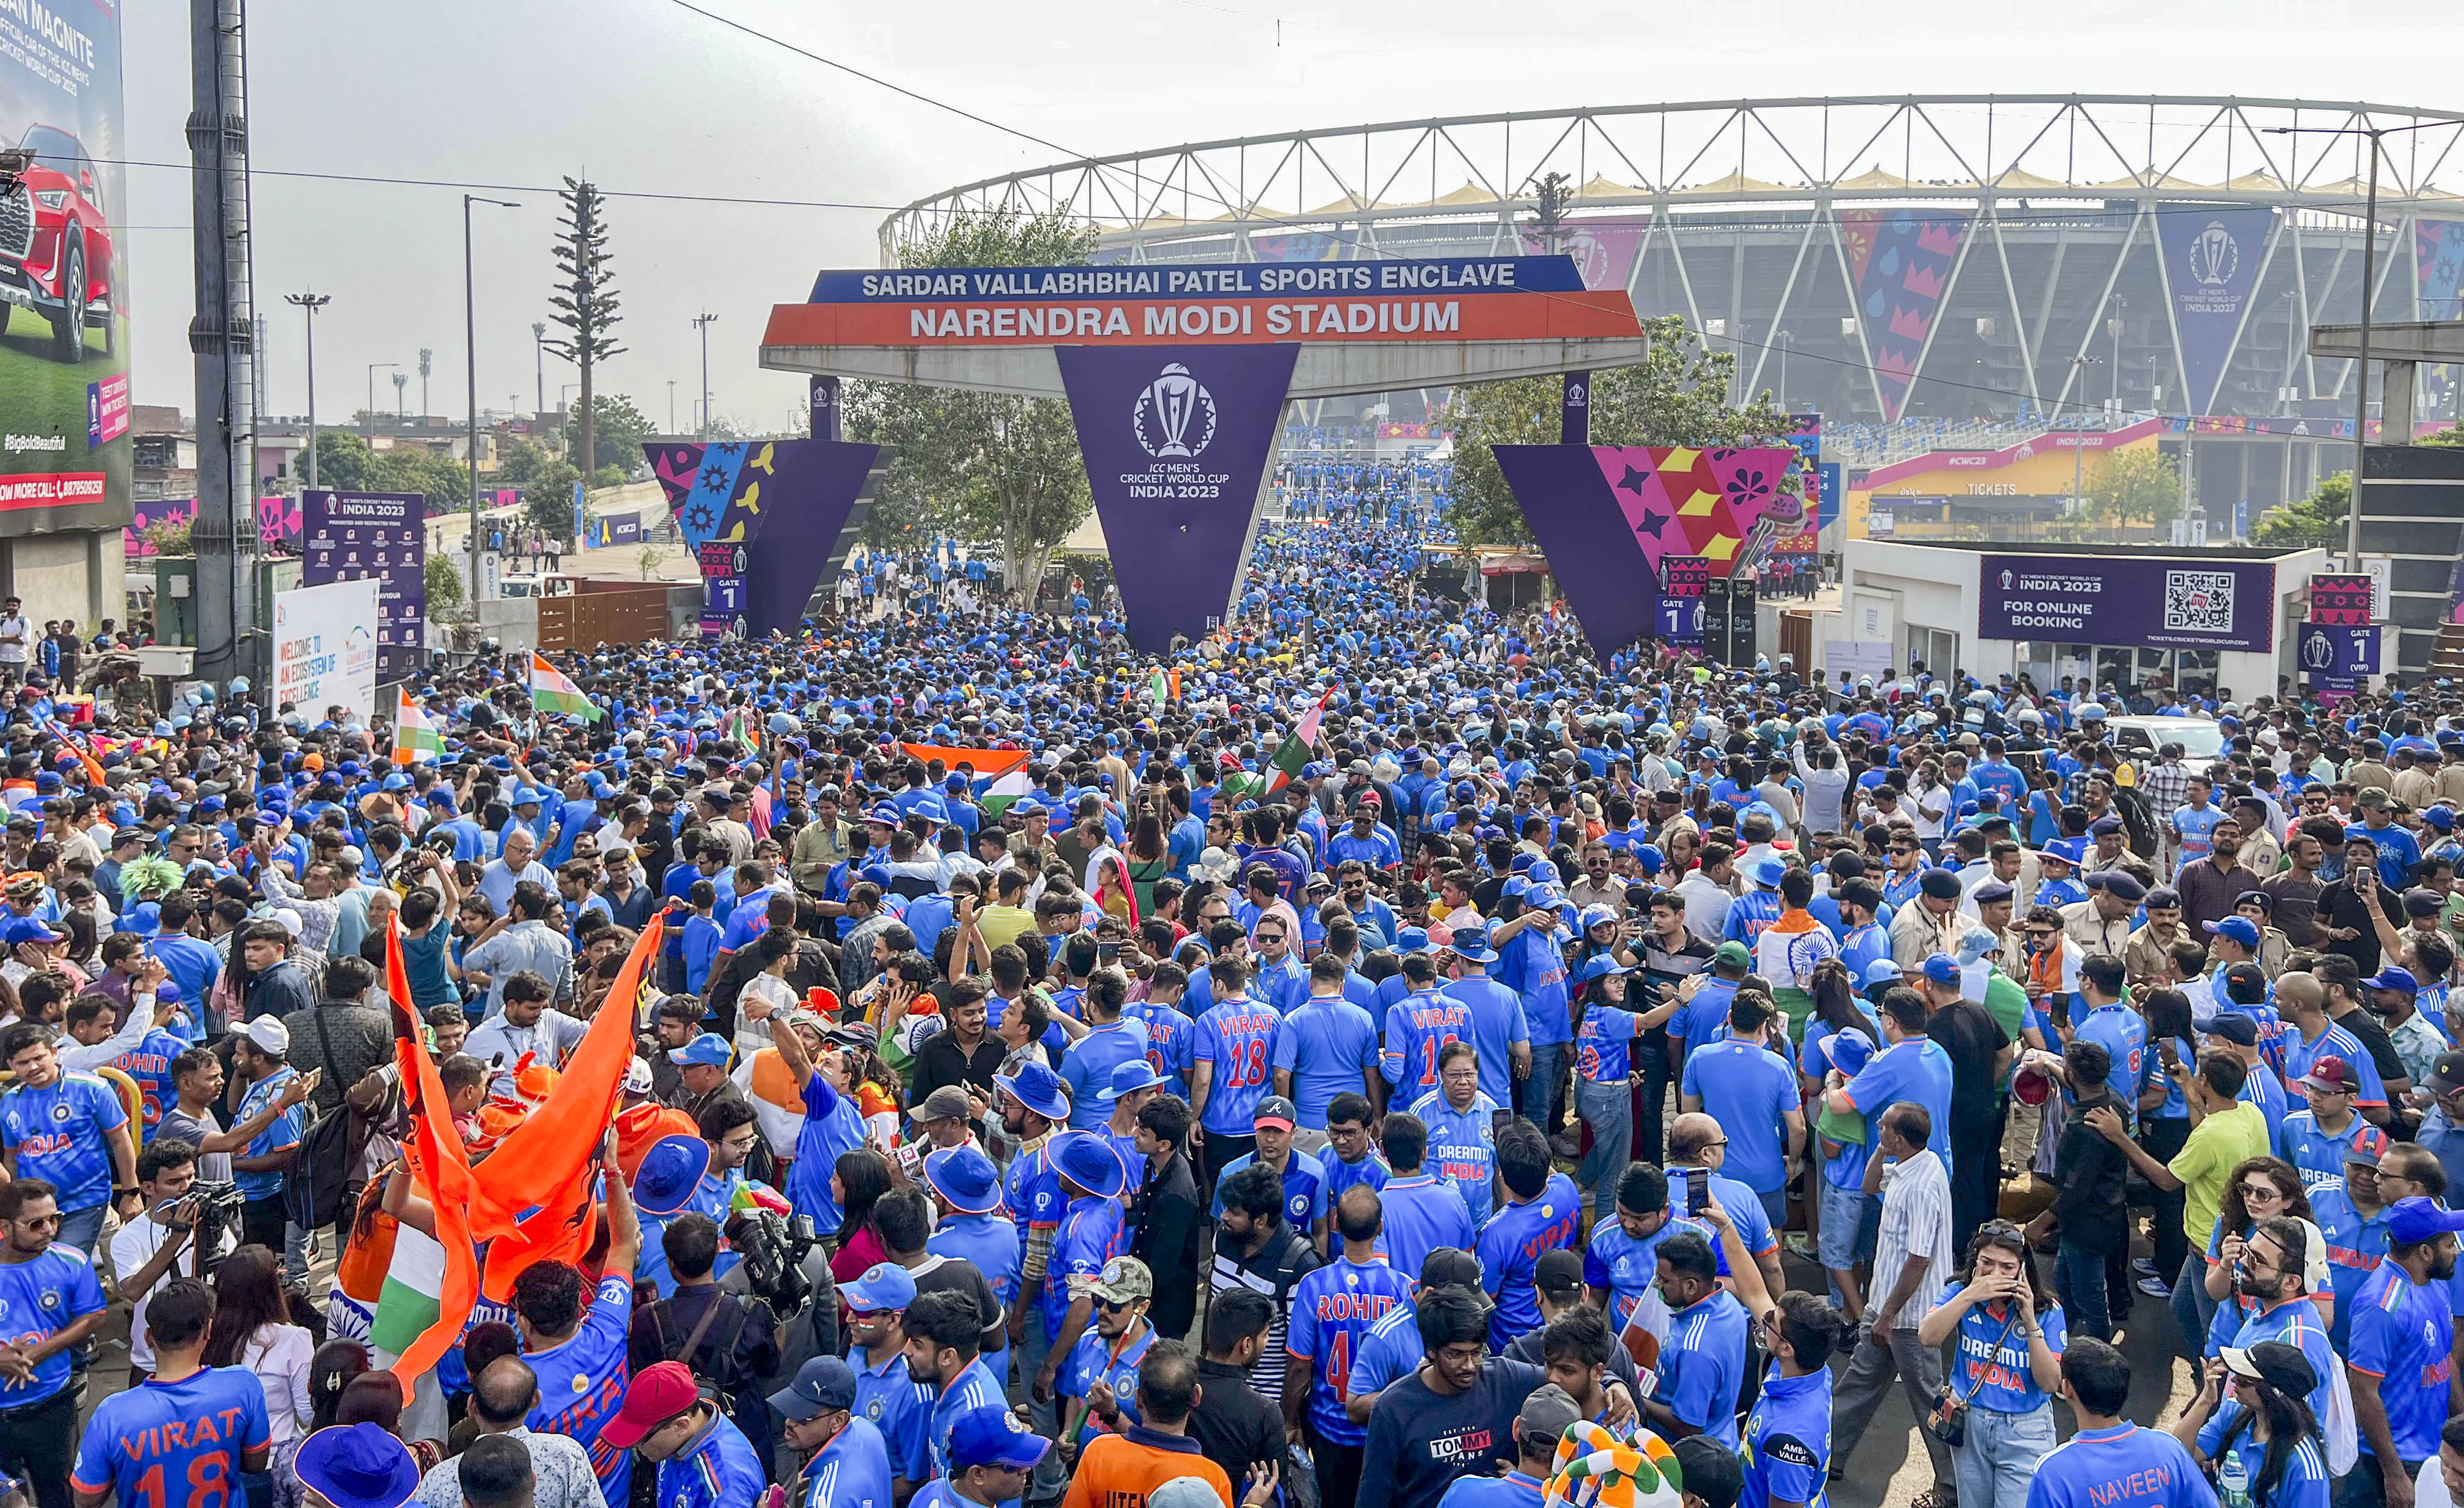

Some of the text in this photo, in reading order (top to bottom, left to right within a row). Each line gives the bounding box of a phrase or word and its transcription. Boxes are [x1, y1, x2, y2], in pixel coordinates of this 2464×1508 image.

[31, 0, 95, 70] MAGNITE
[47, 49, 60, 68] THE
[862, 263, 1515, 296] SARDAR VALLABHBHAI PATEL SPORTS ENCLAVE
[2185, 303, 2236, 313] INDIA 2023
[911, 301, 1459, 337] NARENDRA MODI STADIUM
[5, 434, 66, 454] #BigBoldBeautiful
[1149, 463, 1200, 473] ICC MEN'S
[1949, 456, 1987, 466] #CWC23
[1120, 474, 1229, 484] CRICKET WORLD CUP
[13, 482, 36, 500] MORE
[1130, 486, 1220, 498] INDIA 2023
[1967, 484, 2016, 496] TICKETS
[343, 505, 406, 517] INDIA 2023
[2020, 580, 2102, 593] INDIA 2023
[722, 588, 735, 608] 1
[1662, 600, 1684, 608] GATE
[2003, 600, 2092, 615] FOR ONLINE
[1666, 609, 1678, 633] 1
[2011, 615, 2083, 629] BOOKING
[280, 635, 321, 662] WELCOME TO
[2146, 635, 2249, 646] TICKETS.CRICKETWORLDCUP.COM
[2354, 639, 2365, 662] 1
[280, 664, 290, 686] AN
[292, 657, 327, 683] ECOSYSTEM
[329, 654, 336, 673] OF
[2350, 663, 2369, 672] (VIP)
[280, 680, 320, 705] EXCELLENCE
[1277, 880, 1293, 899] 7
[1217, 1014, 1273, 1037] VIRAT
[1411, 1007, 1465, 1029] VIRAT
[1227, 1039, 1266, 1089] 18
[1266, 1101, 1282, 1114] A
[1441, 1161, 1485, 1181] INDIA
[1524, 1208, 1579, 1259] VIRAT
[2326, 1243, 2382, 1272] INDIA
[1317, 1292, 1396, 1323] ROHIT
[1326, 1330, 1350, 1403] 4
[1965, 1359, 2026, 1395] INDIA
[121, 1407, 241, 1463] VIRAT
[1431, 1430, 1490, 1457] TOMMY
[1442, 1450, 1483, 1463] JEANS
[133, 1449, 230, 1508] 18
[2088, 1466, 2170, 1508] NAVEEN
